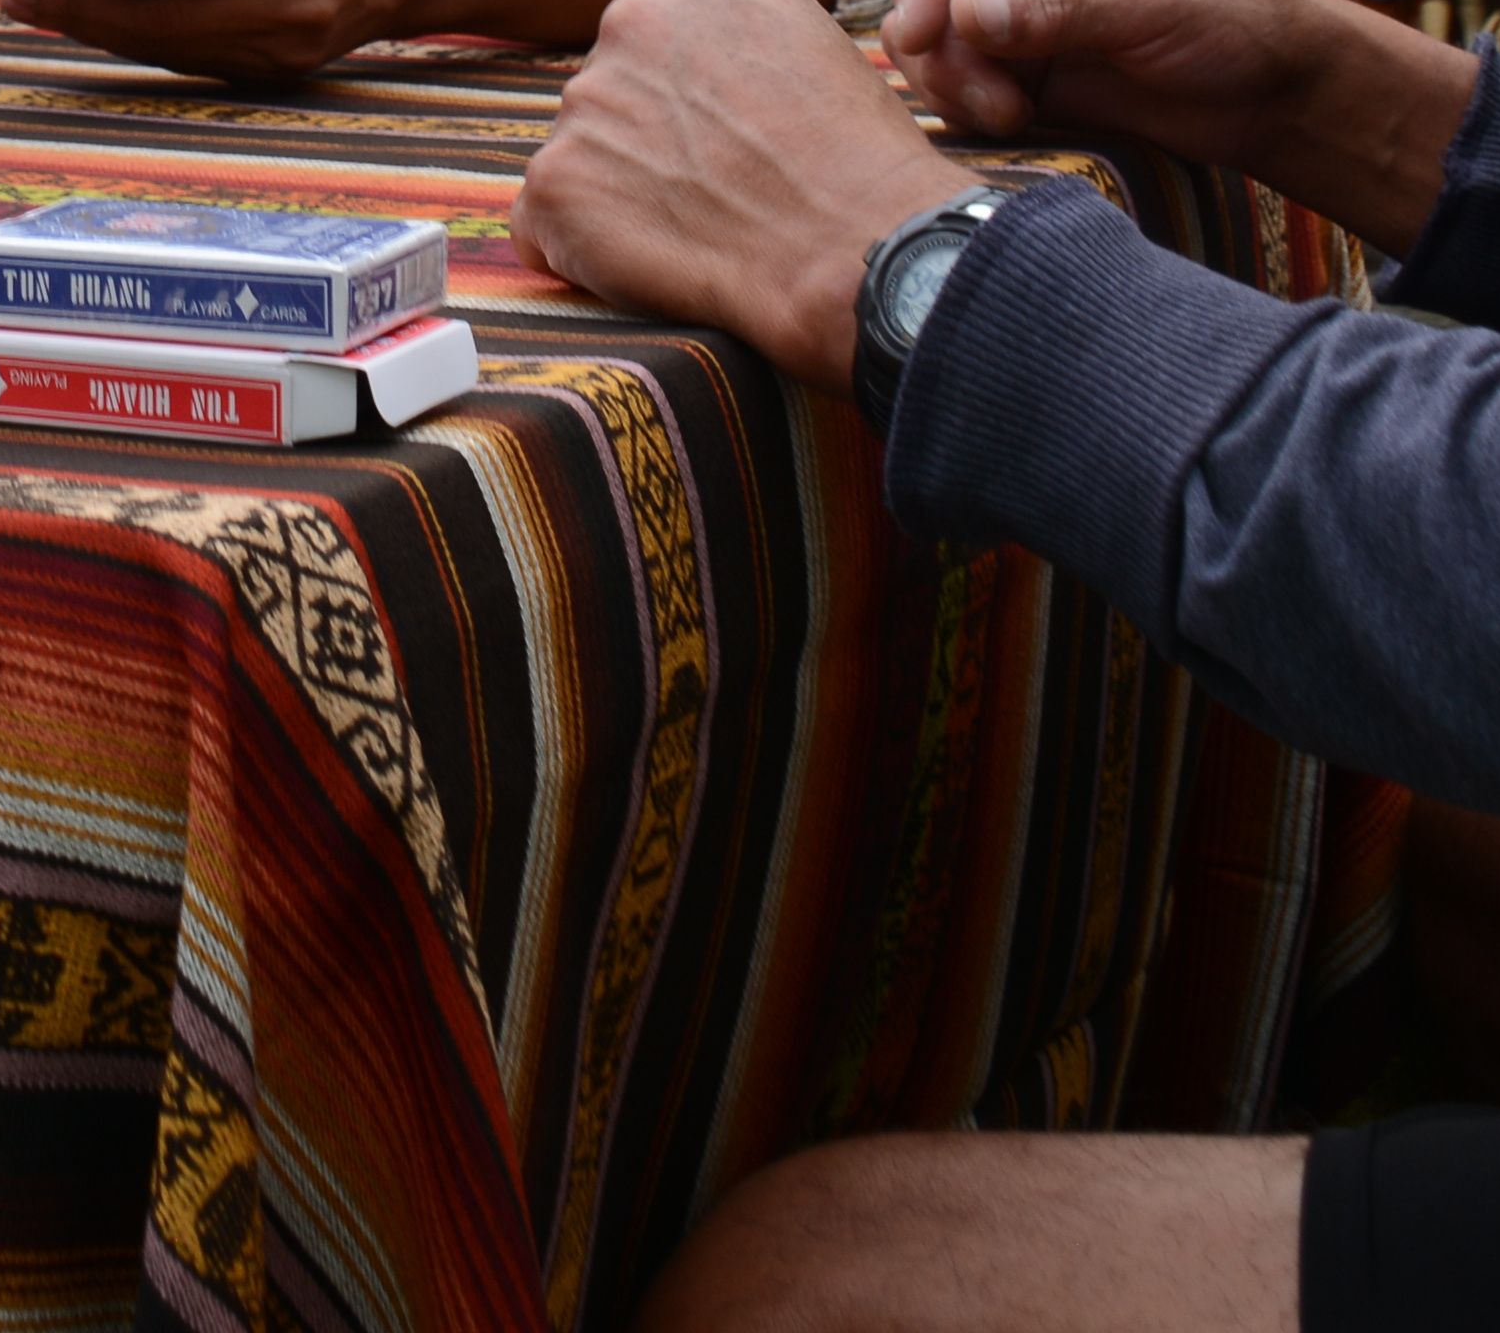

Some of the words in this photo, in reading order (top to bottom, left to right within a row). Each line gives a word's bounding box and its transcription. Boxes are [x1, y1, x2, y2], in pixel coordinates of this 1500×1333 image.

[2, 268, 51, 304] TUN
[70, 273, 151, 310] HUANG
[173, 298, 233, 319] PLAYING
[260, 304, 308, 324] CARDS
[9, 368, 68, 390] PLAYING
[89, 378, 170, 419] HUANG
[190, 387, 240, 425] TUN
